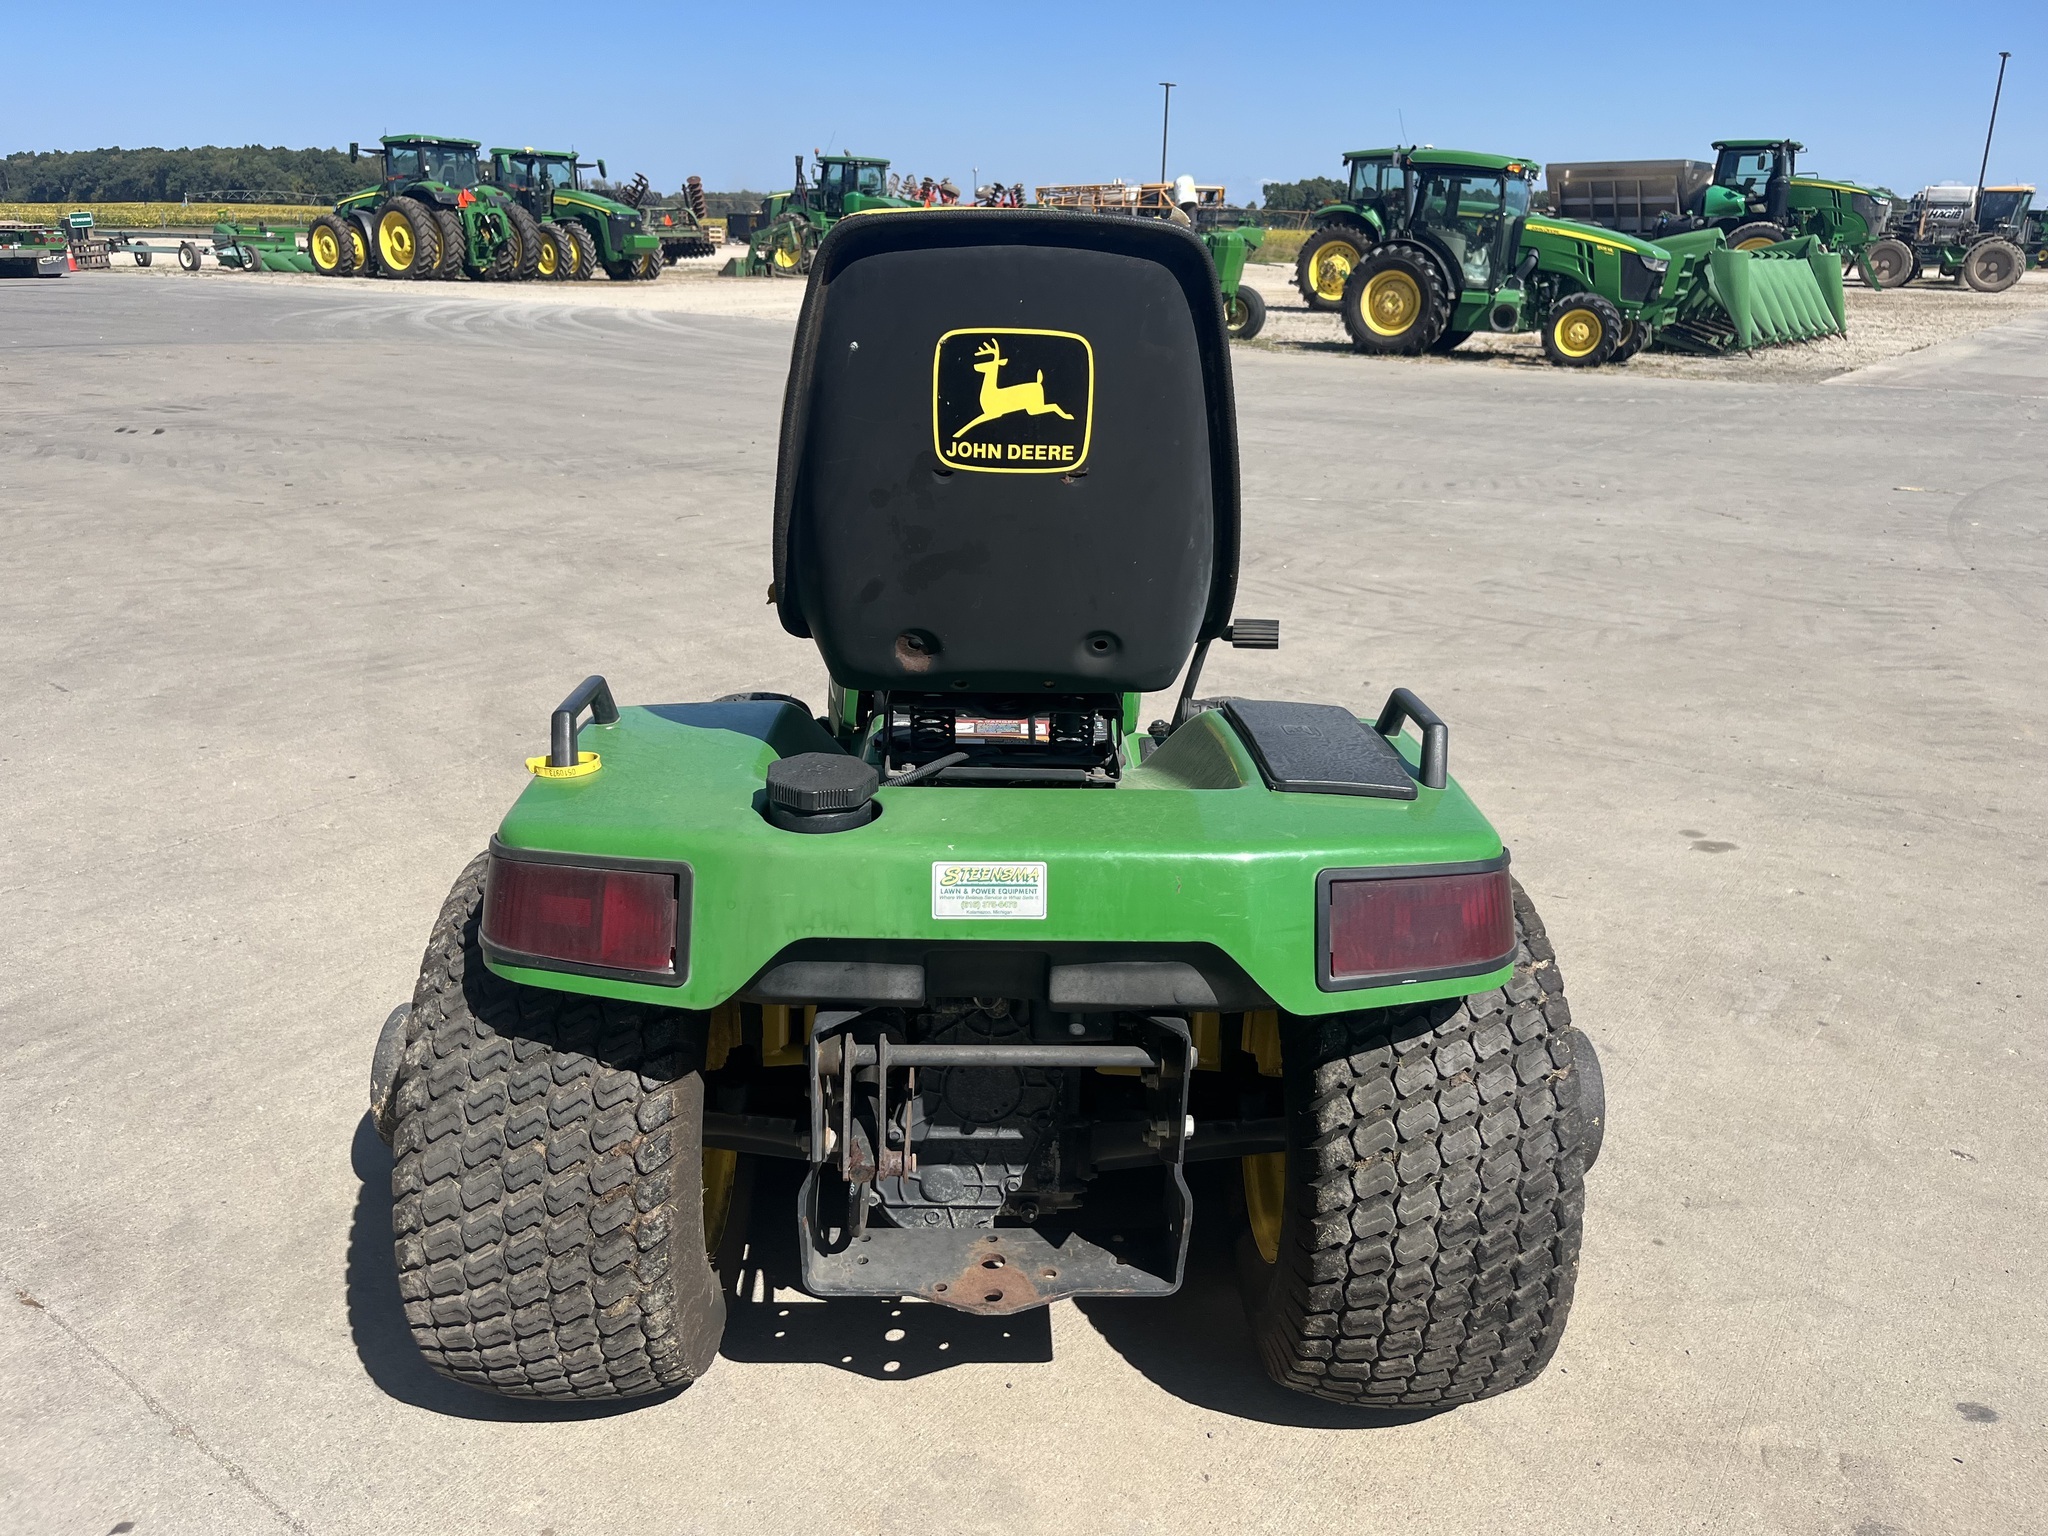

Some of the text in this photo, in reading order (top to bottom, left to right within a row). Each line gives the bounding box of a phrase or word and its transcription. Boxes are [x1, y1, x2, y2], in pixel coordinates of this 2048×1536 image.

[946, 441, 1075, 461] JOHN DEERE
[940, 866, 1040, 886] STEENSMA
